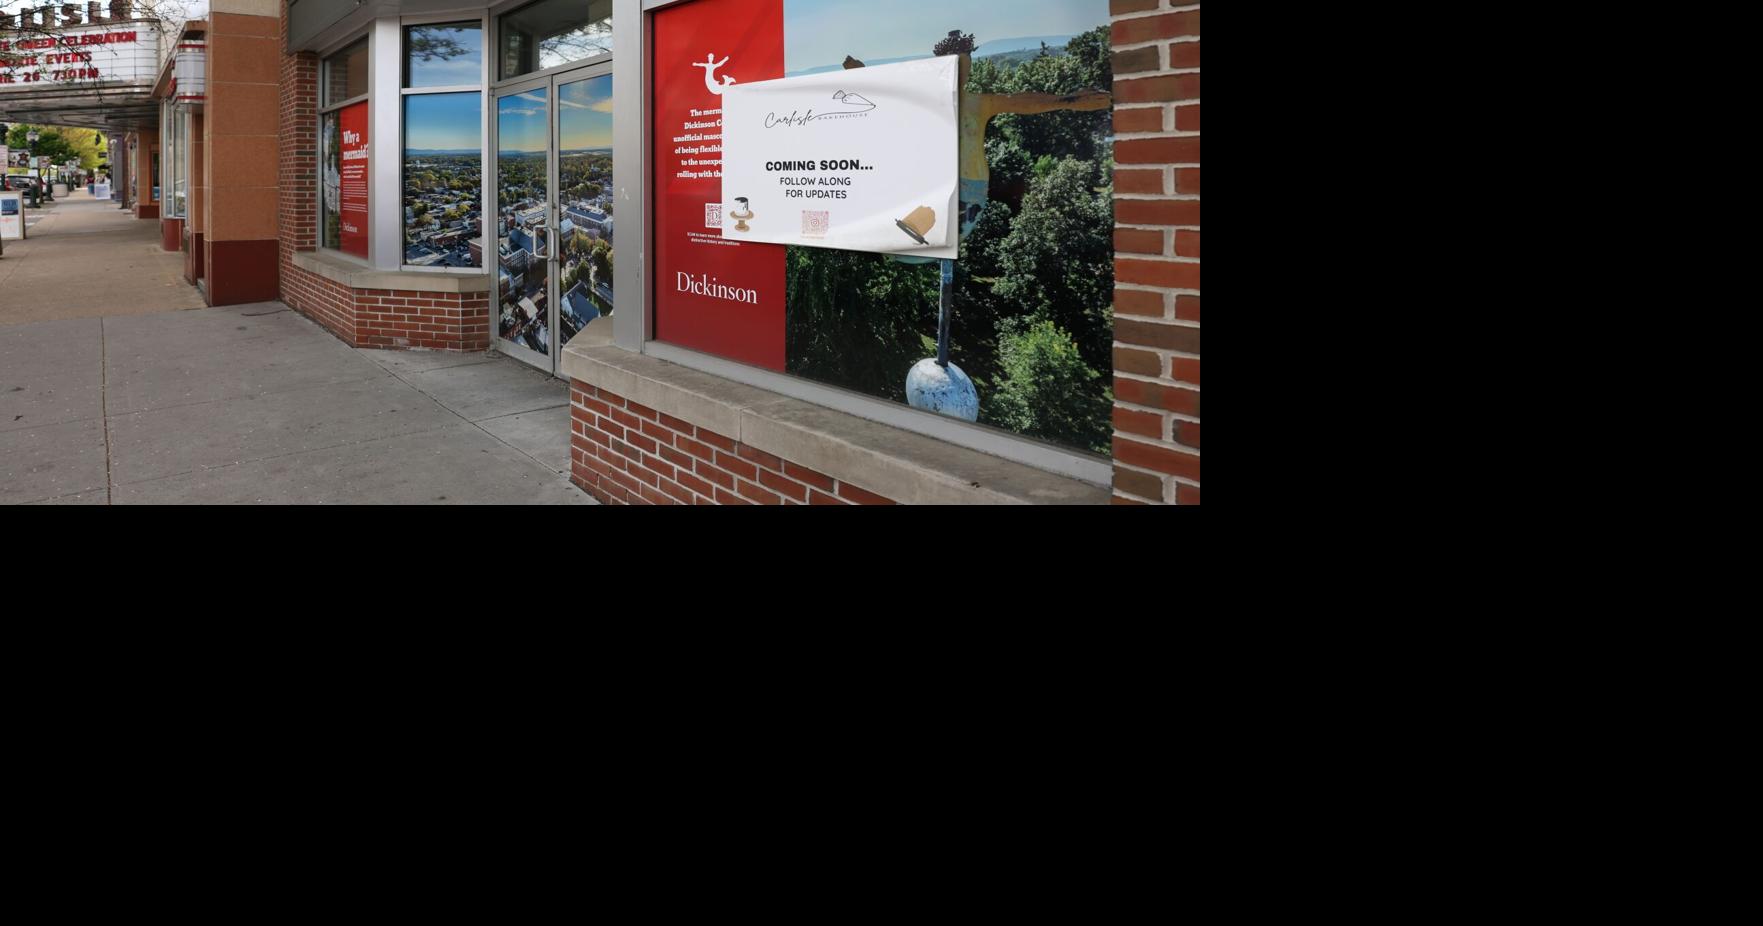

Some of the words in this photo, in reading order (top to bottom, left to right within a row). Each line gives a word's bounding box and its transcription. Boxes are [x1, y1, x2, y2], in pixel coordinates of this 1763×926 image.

[690, 109, 702, 117] The
[765, 109, 814, 129] Carlisle
[684, 121, 715, 130] Dickinson
[343, 130, 355, 147] Why
[356, 132, 360, 143] a
[673, 133, 702, 142] unofficial
[682, 146, 699, 155] being
[688, 158, 698, 166] the
[766, 160, 815, 171] COMING
[820, 159, 873, 171] SOON...
[677, 170, 697, 179] rolling
[698, 169, 713, 178] with
[780, 177, 816, 186] FOLLOW
[818, 177, 851, 186] ALONG
[786, 189, 803, 198] FOR
[806, 189, 847, 199] UPDATES
[677, 271, 758, 304] Dickinson
